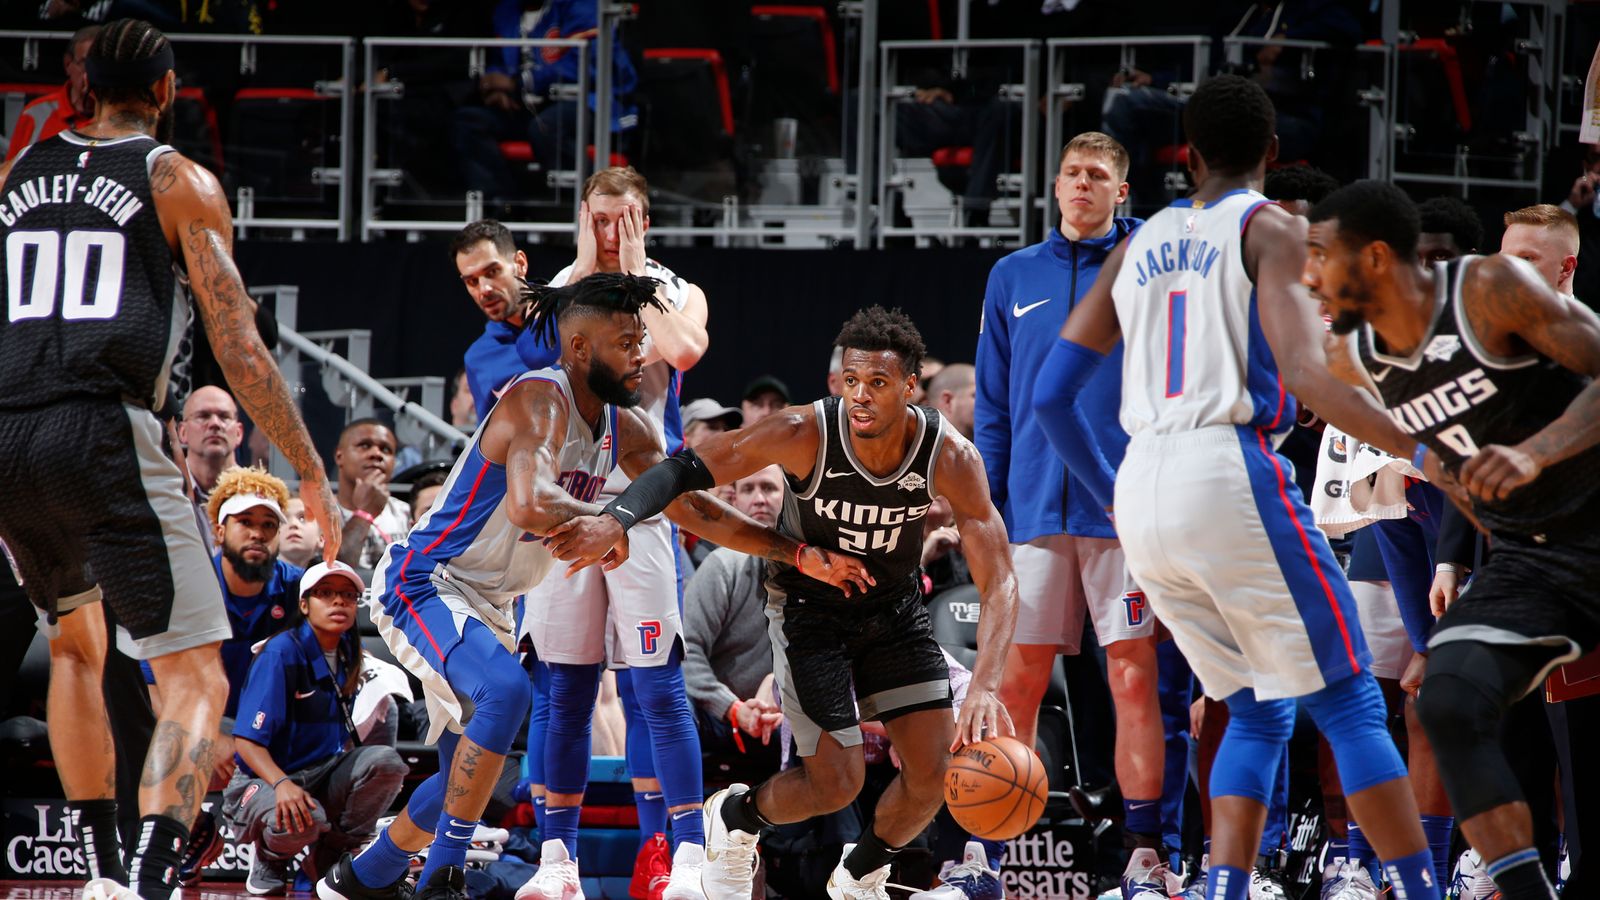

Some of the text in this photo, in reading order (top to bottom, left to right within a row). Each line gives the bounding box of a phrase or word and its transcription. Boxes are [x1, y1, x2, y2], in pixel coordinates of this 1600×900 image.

[0, 174, 143, 227] CAULEY-STEIN
[6, 230, 125, 323] 00
[1165, 289, 1187, 399] 1
[1388, 367, 1499, 434] KINGS
[814, 497, 931, 526] KINGS
[838, 526, 902, 556] 24
[7, 835, 87, 875] Caes
[1000, 830, 1074, 868] ittle
[1001, 869, 1090, 899] esars
